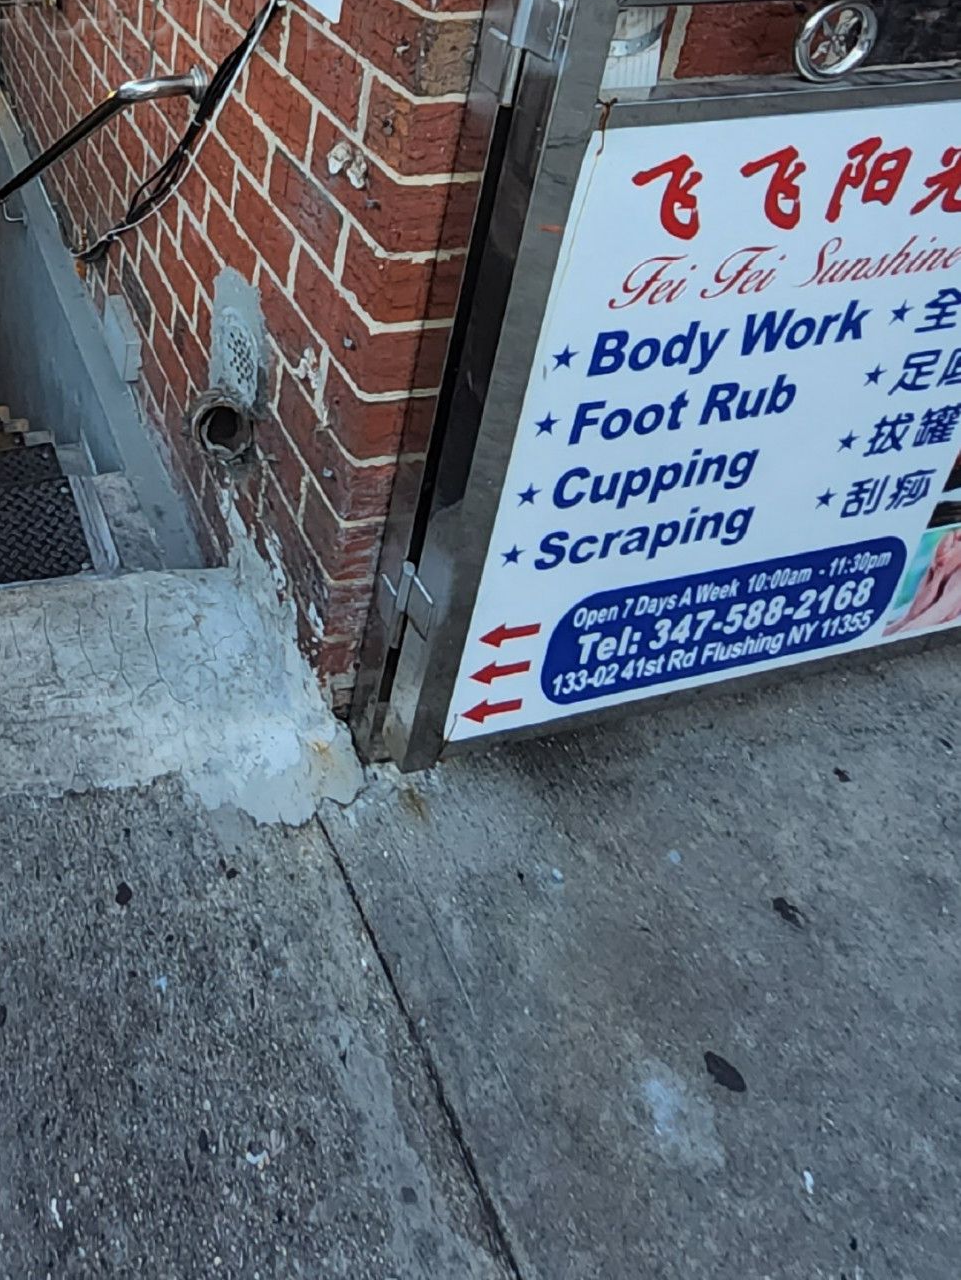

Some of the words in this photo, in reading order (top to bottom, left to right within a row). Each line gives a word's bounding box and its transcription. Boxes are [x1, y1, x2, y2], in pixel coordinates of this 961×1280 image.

[608, 255, 697, 310] Fei
[700, 246, 786, 300] Fei
[798, 236, 961, 288] Sunshine
[587, 322, 728, 377] Body
[740, 300, 873, 356] Work
[568, 389, 689, 445] Foot
[699, 375, 797, 425] Rub
[552, 445, 759, 510] Cupping
[840, 469, 937, 518] 刮痧
[534, 502, 754, 571] Scraping
[574, 605, 617, 628] Open
[622, 599, 634, 618] 7
[634, 592, 675, 619] Days
[677, 588, 692, 607] A
[695, 579, 740, 603] Week
[747, 567, 812, 593] 10:00am
[829, 549, 892, 578] 11:30pm
[578, 626, 640, 665] Tel:
[649, 577, 875, 651] 347-588-2168
[552, 663, 616, 696] 133-02
[621, 656, 664, 680] 41st
[668, 648, 695, 671] Rd
[701, 631, 782, 666] Flushing
[787, 621, 821, 647] NY
[821, 609, 875, 639] 11355
